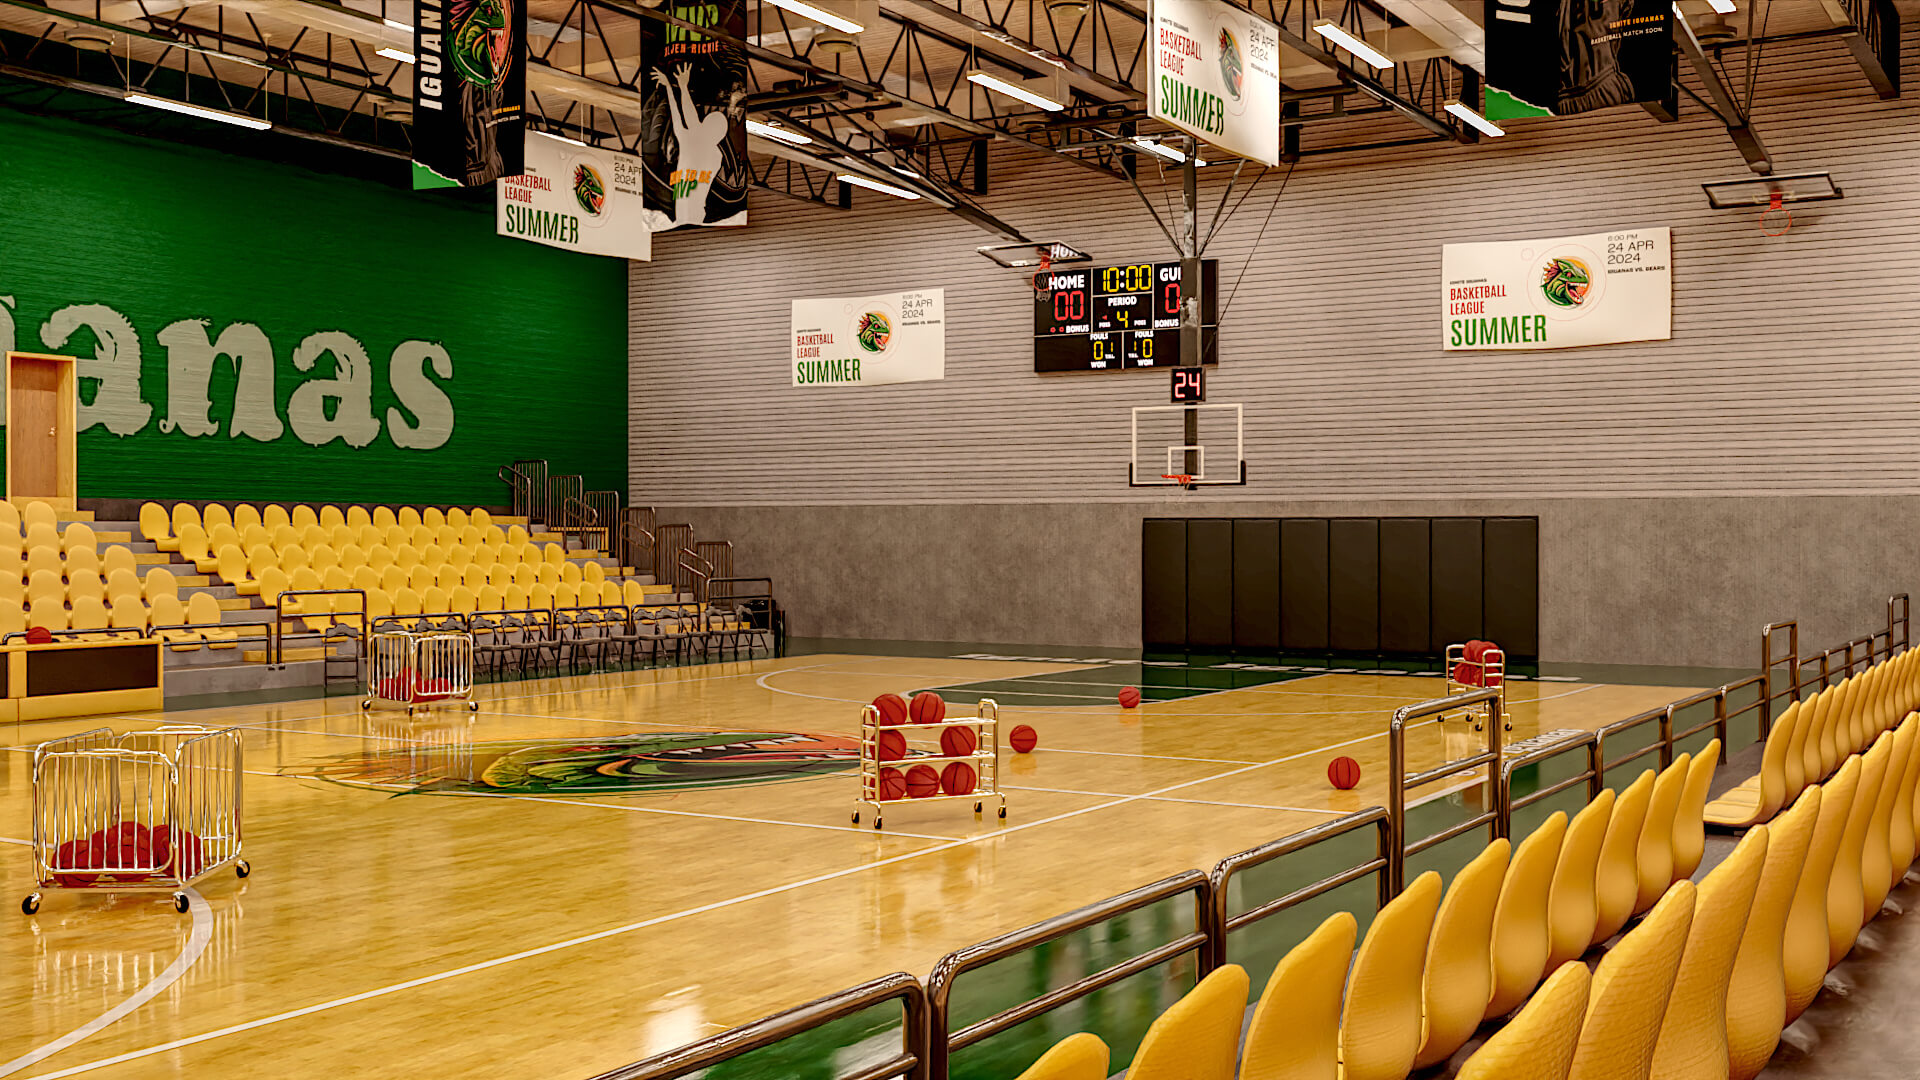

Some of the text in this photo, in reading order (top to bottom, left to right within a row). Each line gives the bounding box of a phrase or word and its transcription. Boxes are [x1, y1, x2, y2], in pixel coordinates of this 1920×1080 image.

[1623, 29, 1644, 37] MATCH
[1160, 28, 1203, 61] BASKETBALL
[1160, 50, 1185, 76] LEAGUE
[1161, 74, 1224, 136] SUMMER
[614, 162, 625, 173] 24
[614, 173, 636, 187] 2024
[684, 168, 697, 182] TO
[505, 186, 532, 203] LEAGUE
[506, 204, 579, 244] SUMMER
[1608, 240, 1654, 253] 24 APR
[1608, 253, 1641, 264] 2024
[1049, 274, 1085, 290] HOME
[1103, 264, 1151, 293] 10:00
[1450, 284, 1507, 301] BASKETBALL
[902, 298, 932, 309] 24 APR
[1054, 290, 1084, 321] 00
[1107, 296, 1137, 307] PERIOD
[1450, 301, 1485, 316] LEAGUE
[902, 309, 924, 318] 2024
[1117, 310, 1128, 328] 4
[1066, 324, 1089, 334] BONUS
[1154, 318, 1179, 328] BONUS
[1090, 332, 1109, 340] FOULS
[1134, 330, 1154, 338] FOULS
[1451, 315, 1547, 347] SUMMER
[797, 333, 834, 346] BASKETBALL
[797, 346, 821, 359] LEAGUE
[0, 295, 454, 450] anas
[797, 358, 861, 384] SUMMER
[1174, 371, 1200, 398] 24
